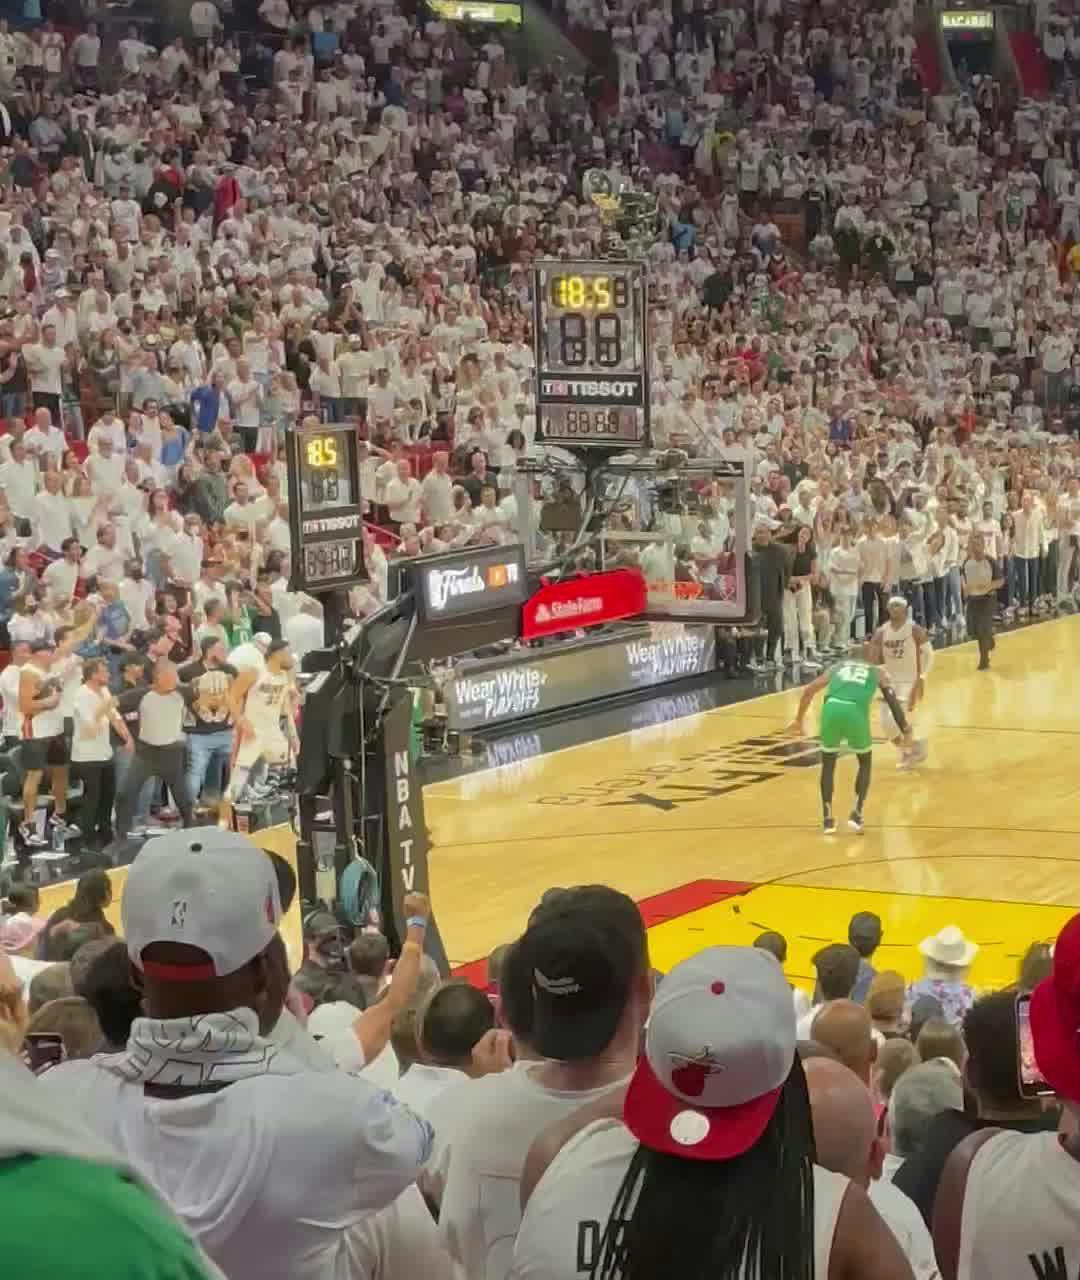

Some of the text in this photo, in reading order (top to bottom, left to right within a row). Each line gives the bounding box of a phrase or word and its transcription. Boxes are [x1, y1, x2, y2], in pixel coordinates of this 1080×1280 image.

[571, 381, 638, 397] TISSOT
[625, 641, 657, 665] Wear
[837, 664, 870, 686] 42
[456, 679, 496, 705] Wear
[393, 751, 413, 828] NBA
[399, 839, 415, 892] TV
